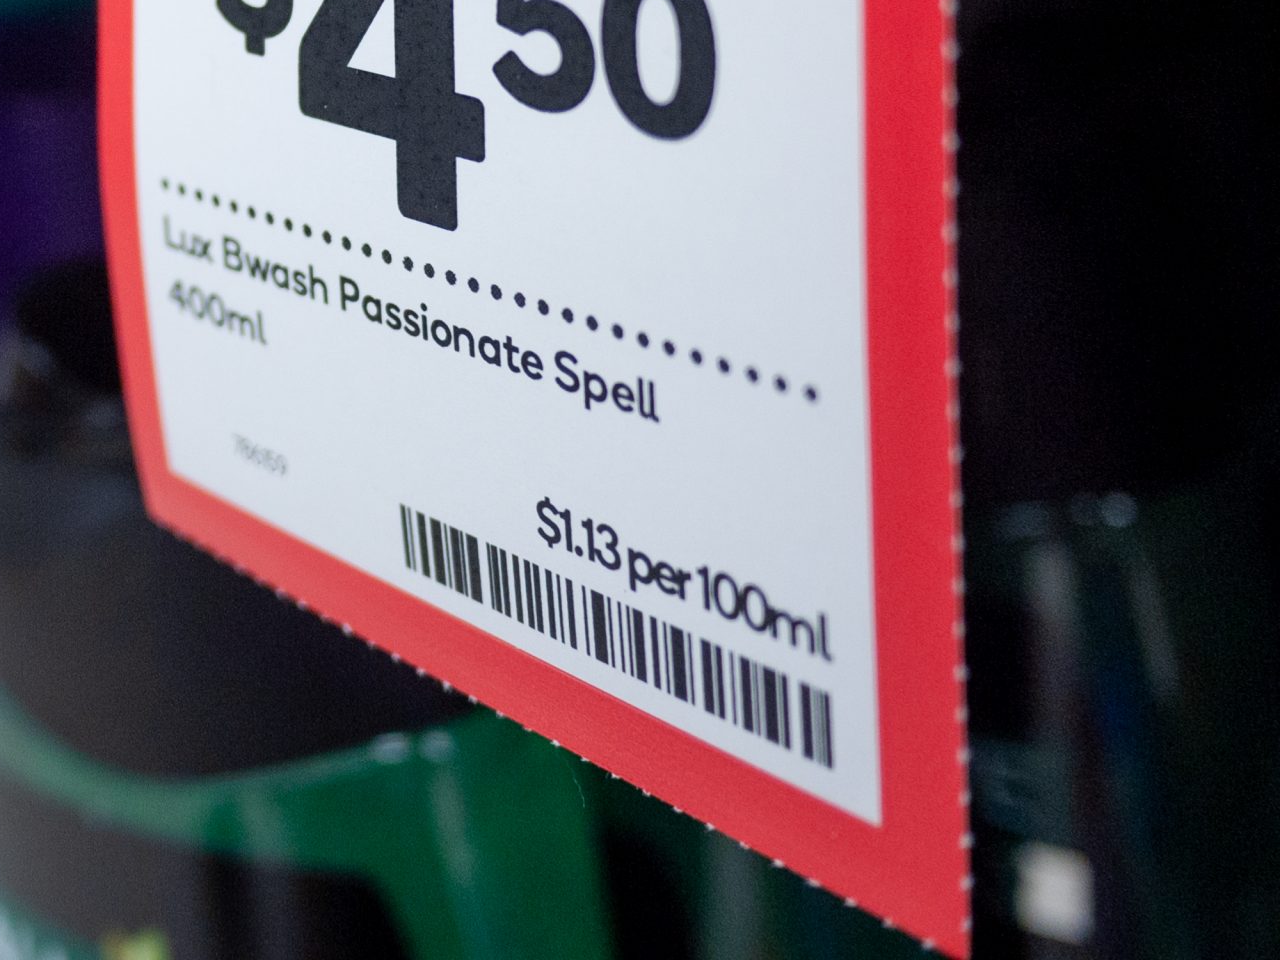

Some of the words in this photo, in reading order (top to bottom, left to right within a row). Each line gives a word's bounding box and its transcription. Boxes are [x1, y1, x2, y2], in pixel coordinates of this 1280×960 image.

[161, 213, 215, 264] Lux
[222, 235, 329, 305] Bwash
[339, 275, 544, 381] Passionate
[554, 350, 660, 423] Spell
[168, 279, 268, 345] 400ml
[535, 496, 622, 571] $1.13
[627, 547, 692, 600] per
[696, 565, 834, 664] 100ml
